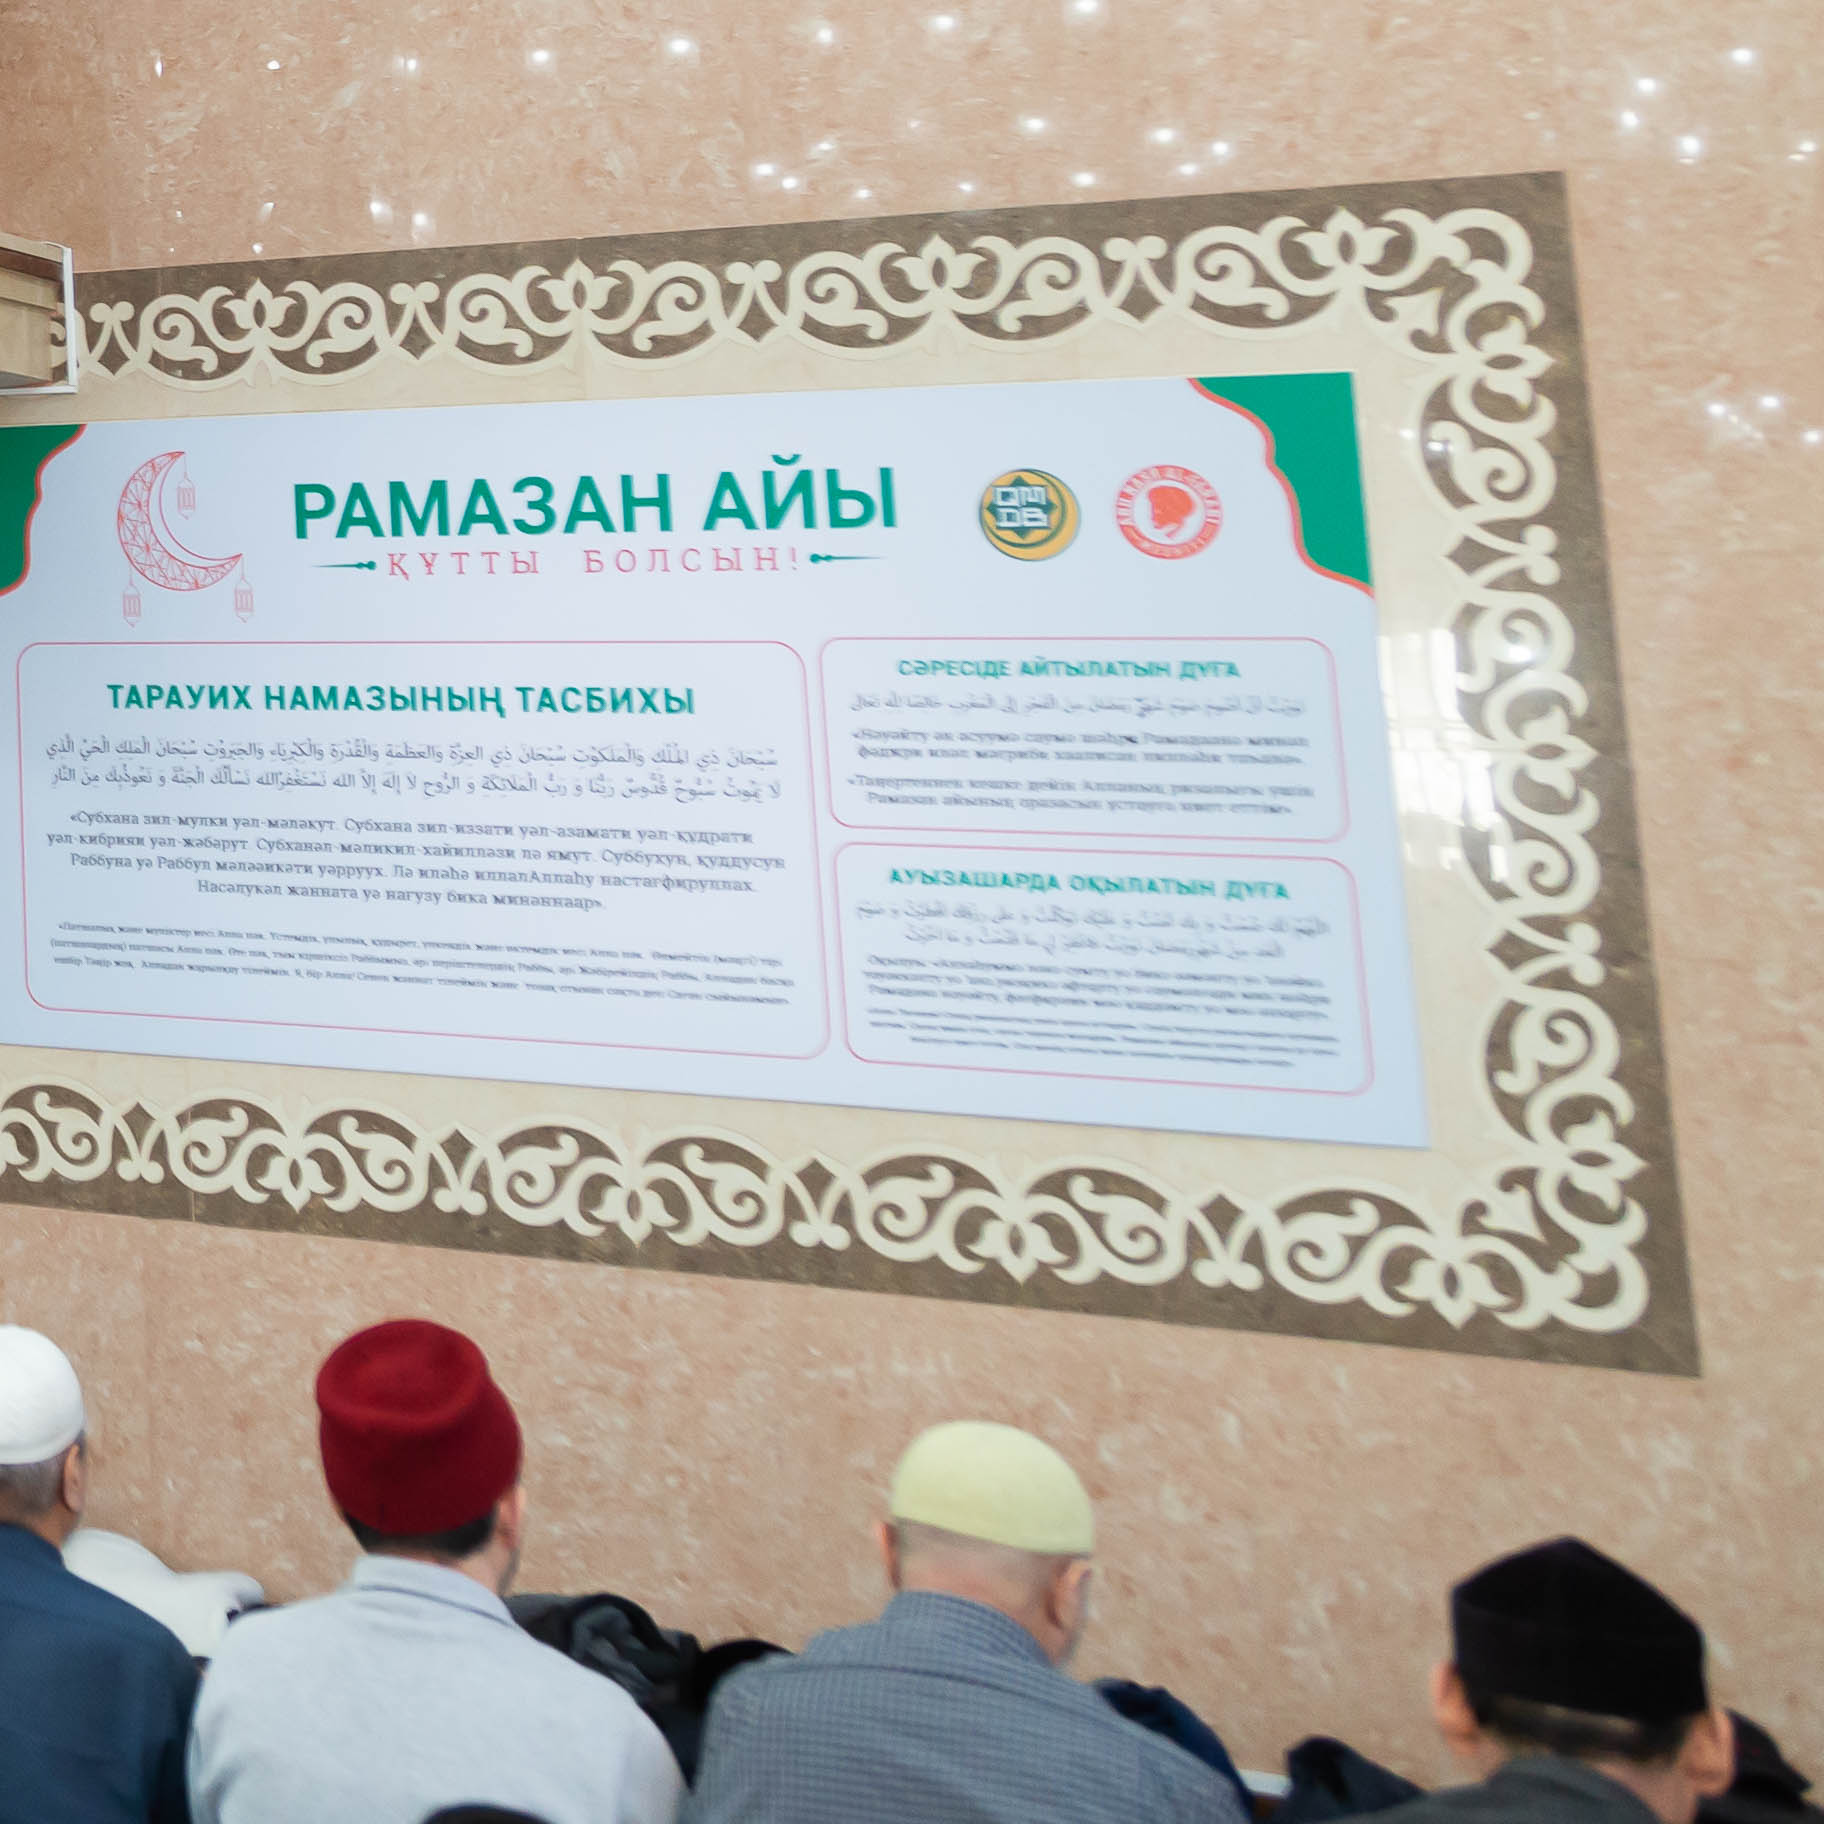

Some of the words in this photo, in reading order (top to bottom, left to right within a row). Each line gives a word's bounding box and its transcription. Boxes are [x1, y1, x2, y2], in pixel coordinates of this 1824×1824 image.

[293, 472, 673, 540] РАМАЗАН
[703, 453, 897, 531] АЙЫ
[387, 550, 539, 581] ҚҰТТЫ
[584, 546, 799, 574] БОЛСЫН!
[1021, 656, 1172, 679] АЙТЫЛАТЫН
[106, 684, 254, 710] ТАРАУИХ
[264, 685, 506, 717] НАМАЗЫНЫҢ
[515, 686, 694, 714] ТАСБИХЫ
[70, 810, 138, 826] «Субхана
[143, 814, 227, 829] зил-мулки
[344, 818, 412, 833] Субхана
[71, 853, 131, 869] Раббуна
[136, 857, 152, 870] уә
[158, 856, 210, 872] Раббул
[392, 864, 412, 877] Лә
[198, 880, 281, 896] Насәлукәл
[288, 885, 357, 898] жанната
[363, 888, 380, 901] уә
[447, 889, 486, 904] бика
[889, 868, 1061, 892] АУЫЗАШАРДА
[1069, 874, 1215, 896] ОҚЫЛАТЫН
